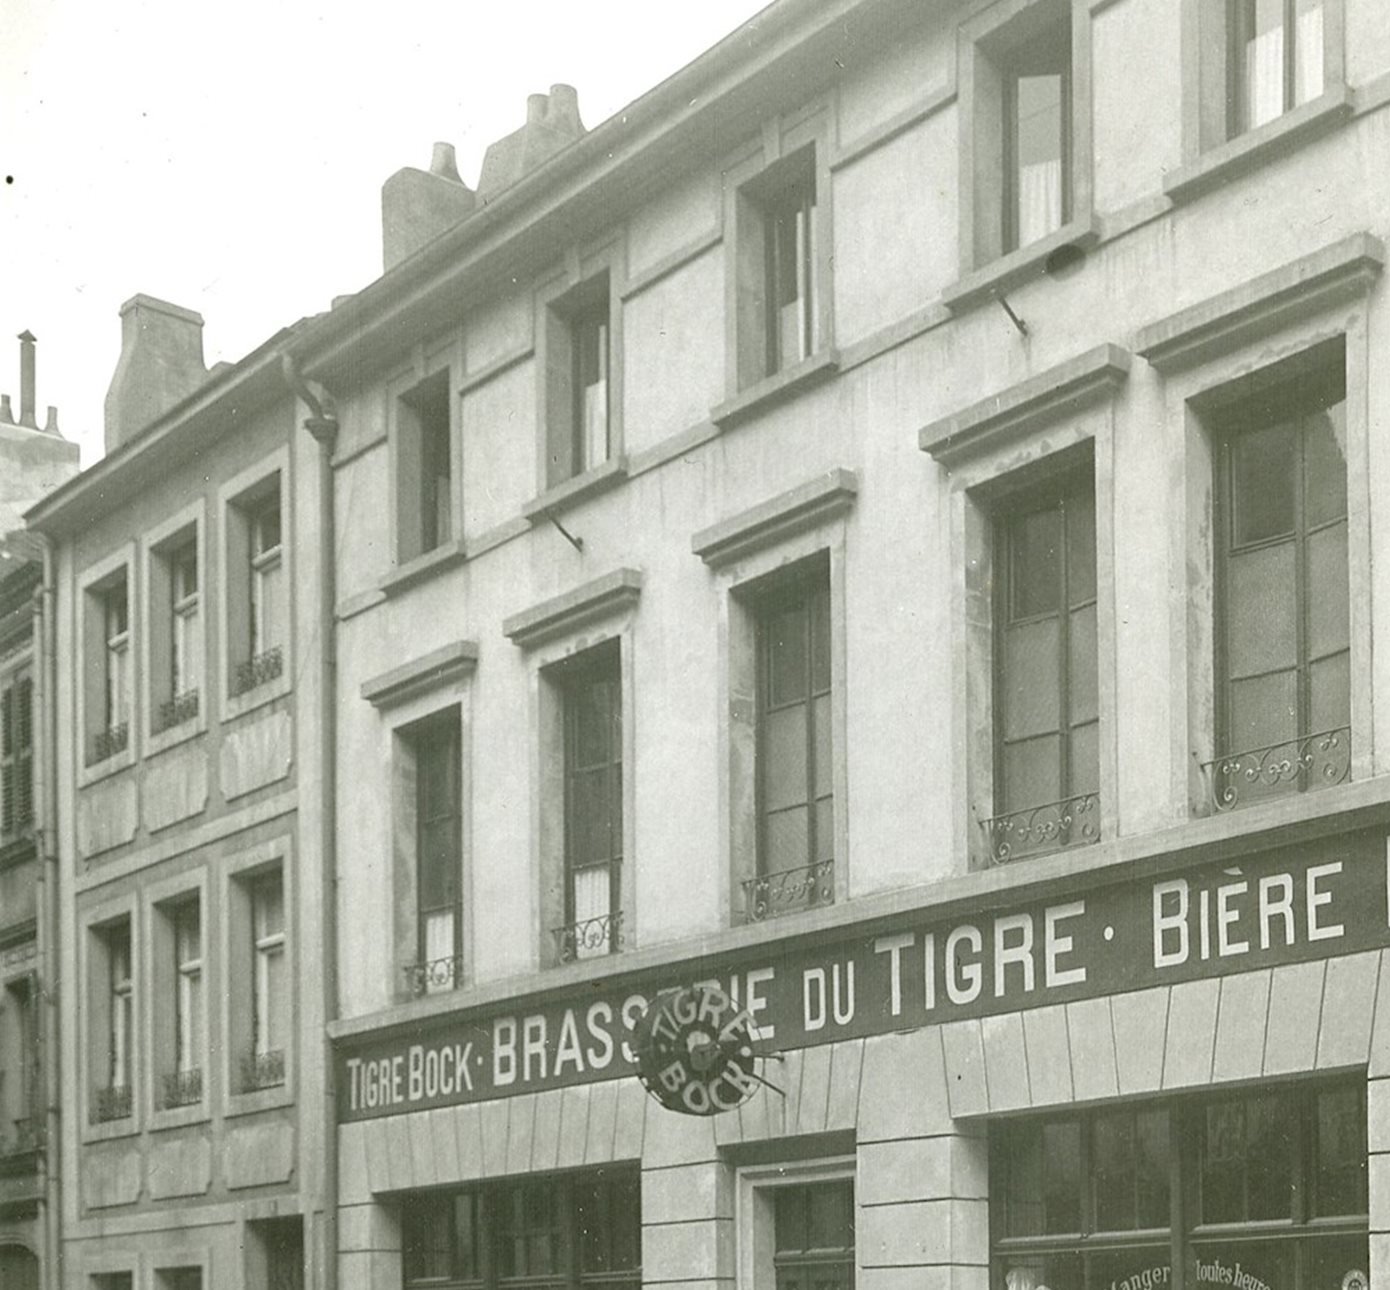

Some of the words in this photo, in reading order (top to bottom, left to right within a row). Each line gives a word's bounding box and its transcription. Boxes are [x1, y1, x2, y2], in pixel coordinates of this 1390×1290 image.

[346, 1056, 404, 1110] TIGRE
[408, 1042, 473, 1101] BOCK
[493, 967, 775, 1086] BRASSIE
[803, 960, 855, 1031] DU
[874, 900, 1087, 1015] TIGRE
[1153, 865, 1345, 968] BIÈRE
[652, 985, 758, 1042] TIGRE
[659, 1060, 761, 1113] BOCK
